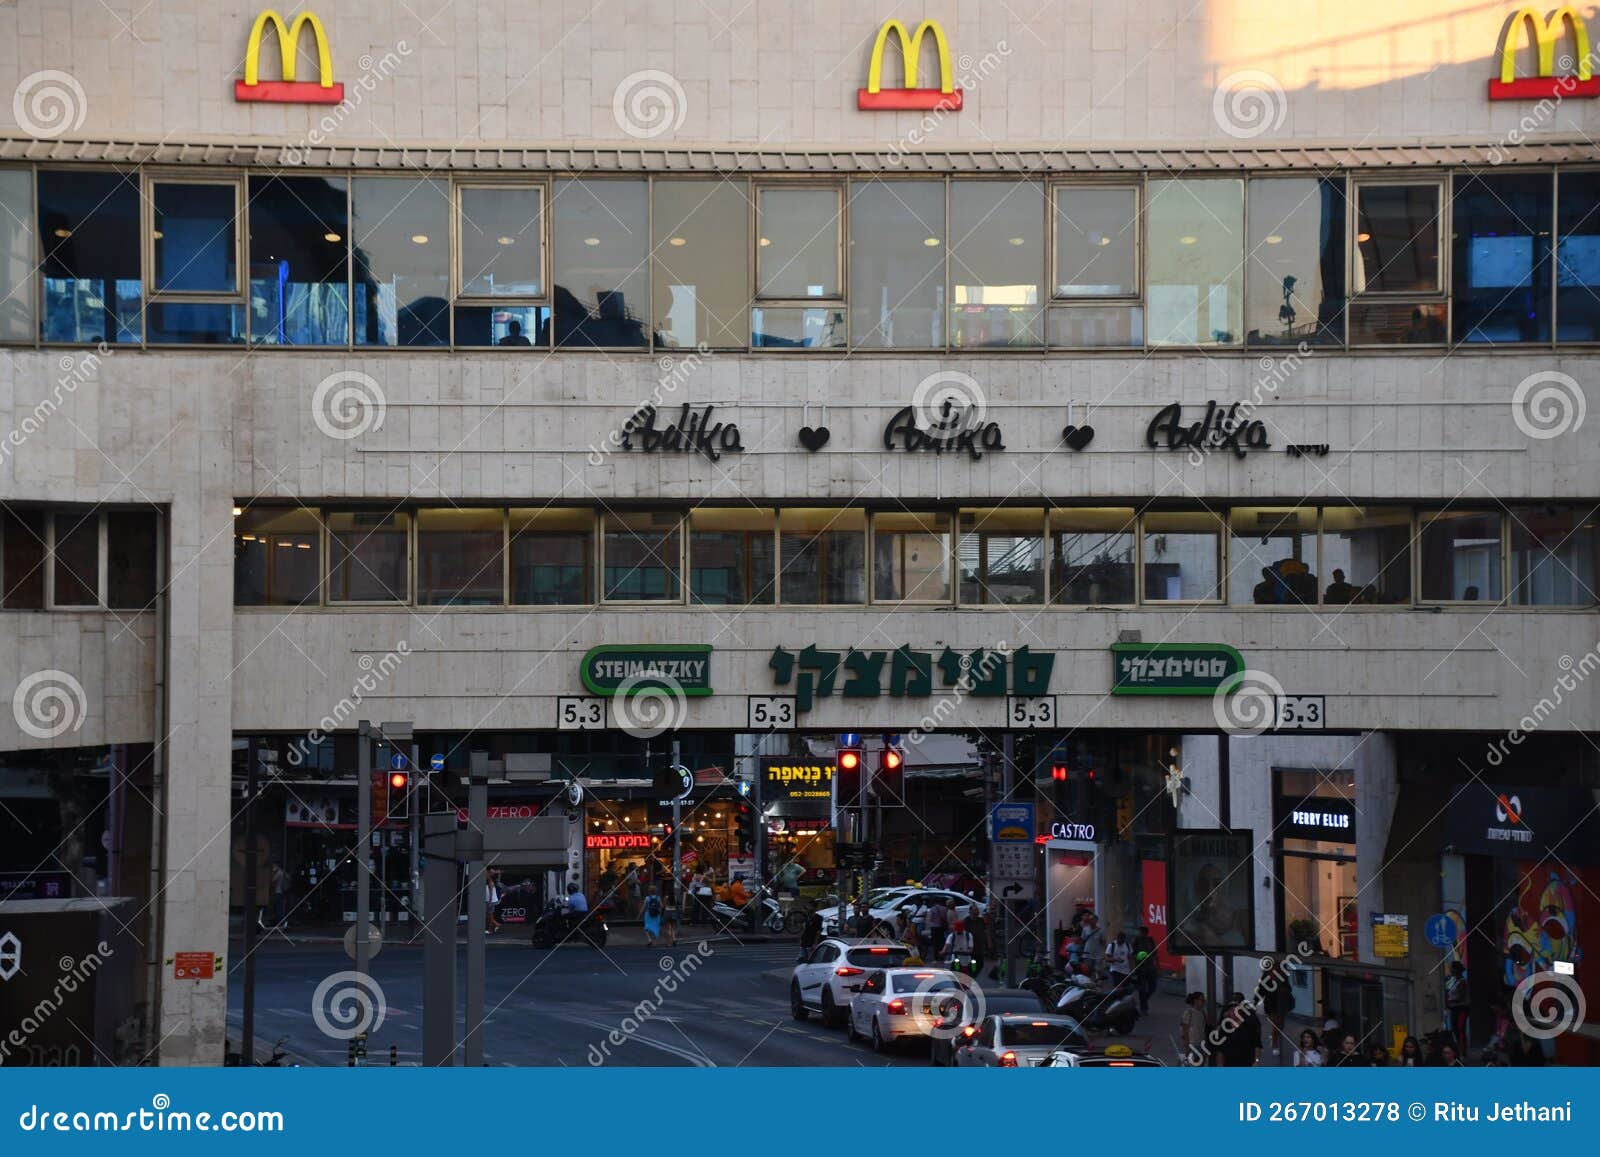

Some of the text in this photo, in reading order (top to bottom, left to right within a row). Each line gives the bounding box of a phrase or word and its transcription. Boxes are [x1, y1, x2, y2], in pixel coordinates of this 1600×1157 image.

[622, 402, 745, 461] Adika
[884, 397, 1006, 460] Adika
[1147, 400, 1272, 459] Adika
[595, 660, 705, 678] STEIMATZKY
[769, 642, 1056, 713] סטימצקי
[1121, 655, 1228, 681] סטימצקי
[564, 704, 601, 723] 5.3
[755, 703, 791, 722] 5.3
[1014, 703, 1051, 722] 5.3
[1283, 703, 1319, 722] 5.3
[489, 806, 532, 819] ZERO
[1292, 810, 1349, 828] PERRY ELLIS
[587, 835, 650, 847] ברוכים הבאים
[1051, 823, 1095, 840] CASTRO
[501, 907, 526, 917] ZERO
